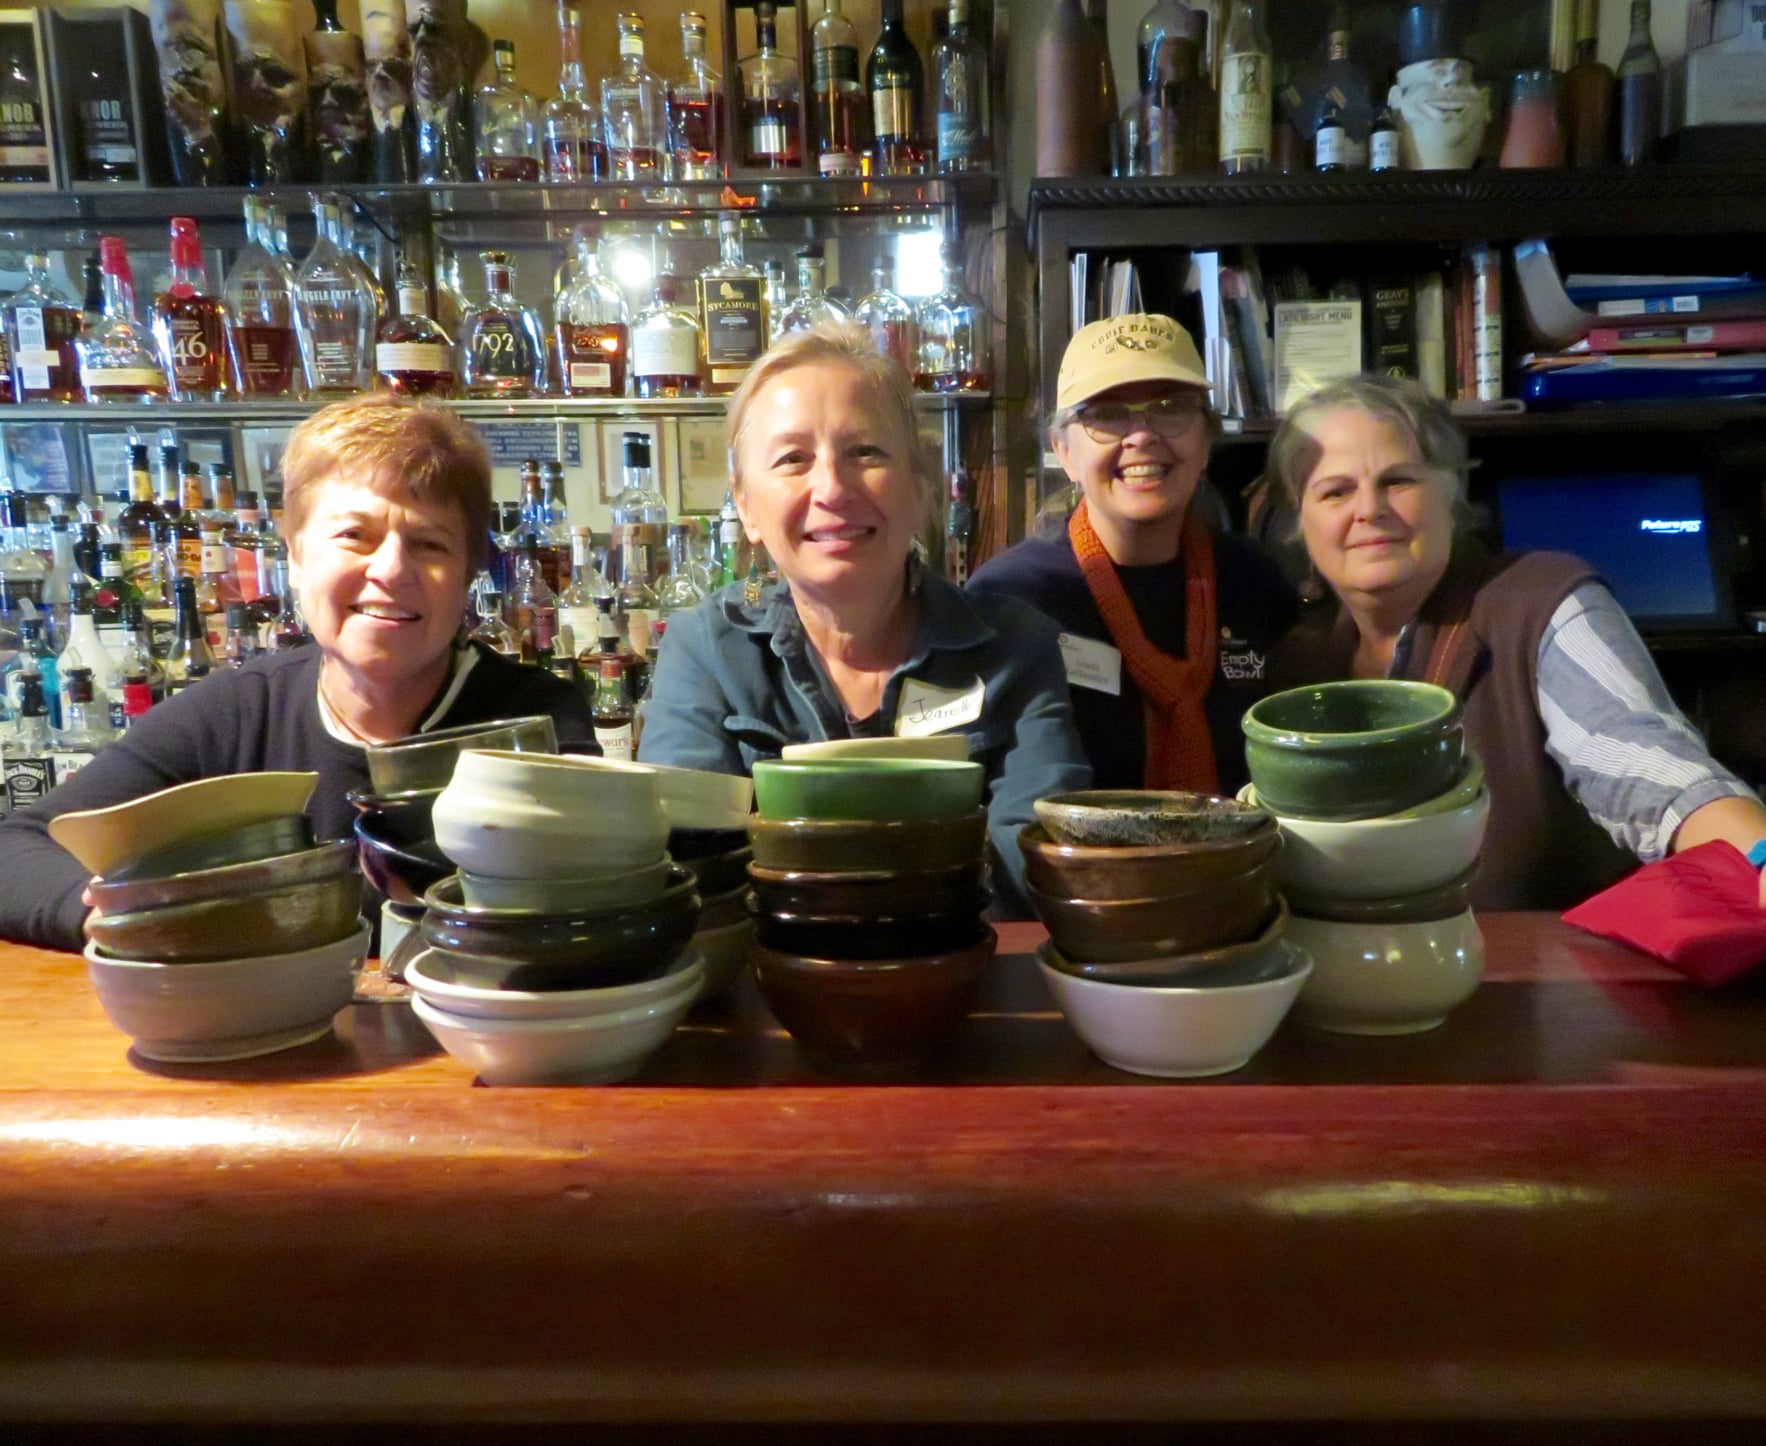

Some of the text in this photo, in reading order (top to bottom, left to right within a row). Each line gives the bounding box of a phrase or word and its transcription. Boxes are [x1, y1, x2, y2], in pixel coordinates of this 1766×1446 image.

[1, 103, 35, 122] NOB
[707, 301, 759, 313] SYCAMORE
[1328, 311, 1353, 320] MENU
[172, 331, 207, 366] 46
[472, 333, 515, 359] 1792
[1221, 649, 1265, 669] Empty
